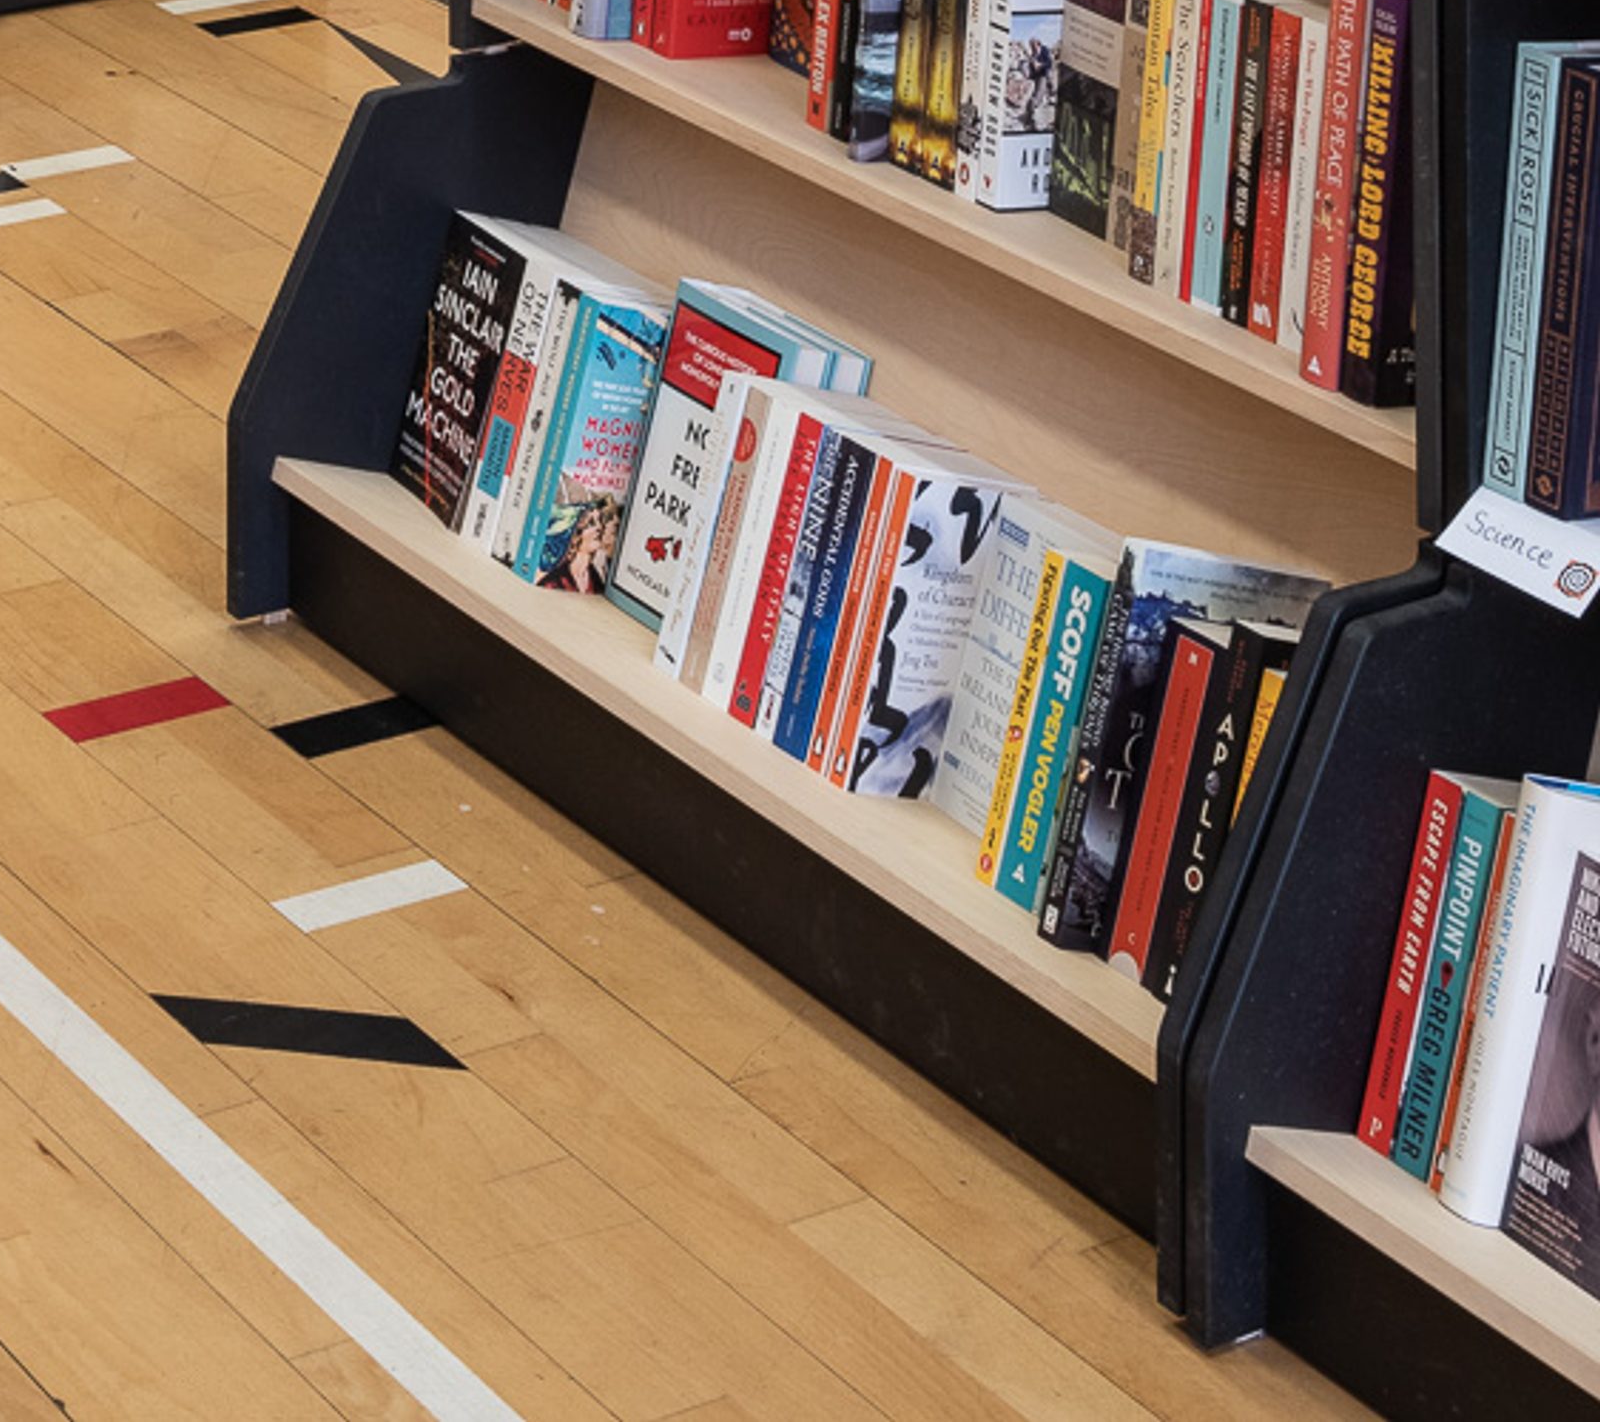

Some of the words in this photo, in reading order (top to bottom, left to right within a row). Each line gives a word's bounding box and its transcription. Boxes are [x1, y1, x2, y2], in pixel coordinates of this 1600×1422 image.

[1144, 74, 1160, 119] Tales
[1170, 35, 1189, 139] Searchers
[1364, 42, 1394, 155] KILLING
[1523, 87, 1544, 147] SICK
[1359, 164, 1386, 239] LORD
[1512, 157, 1536, 219] ROSE
[460, 259, 500, 306] IAIN
[1314, 253, 1332, 330] ANTHONY
[1348, 245, 1376, 359] GEORGE
[433, 286, 506, 354] SINCLAIR
[446, 332, 477, 377] THE
[430, 365, 477, 415] GOLD
[403, 394, 477, 464] MACHINE
[997, 553, 1040, 590] THE
[1465, 509, 1555, 571] Science
[1049, 585, 1093, 700] SCOFF
[1036, 702, 1066, 754] PEN
[1017, 758, 1051, 854] VOGLER
[1521, 803, 1537, 846] THE
[1448, 833, 1484, 960] PINPOINT
[1504, 848, 1527, 944] IMAGINARY
[1485, 945, 1508, 1021] PATIENT
[1422, 984, 1456, 1063] GREG
[1401, 1068, 1441, 1162] MILNER
